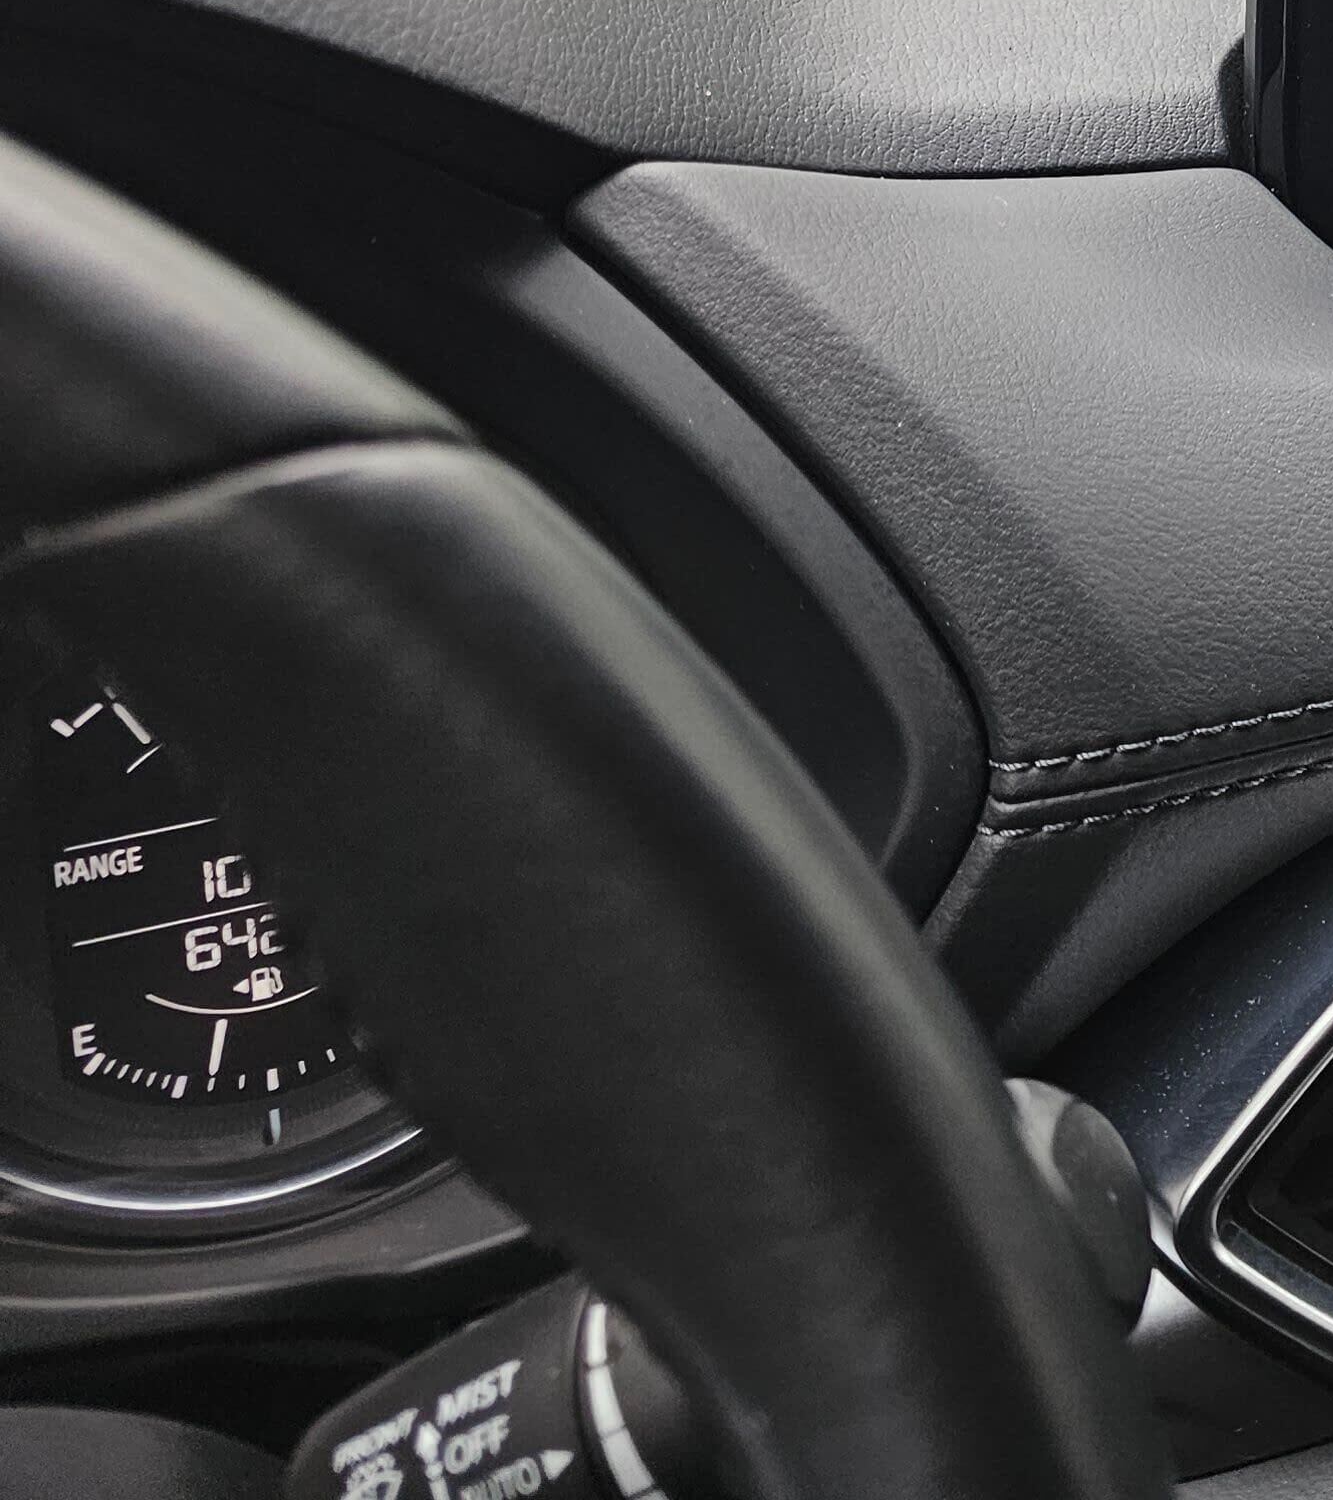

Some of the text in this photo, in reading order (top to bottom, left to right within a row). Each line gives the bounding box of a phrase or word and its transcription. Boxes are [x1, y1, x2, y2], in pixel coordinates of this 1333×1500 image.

[53, 846, 144, 888] RANGE
[71, 1023, 97, 1058] E
[436, 1359, 522, 1429] MIST
[443, 1413, 511, 1475] OFF
